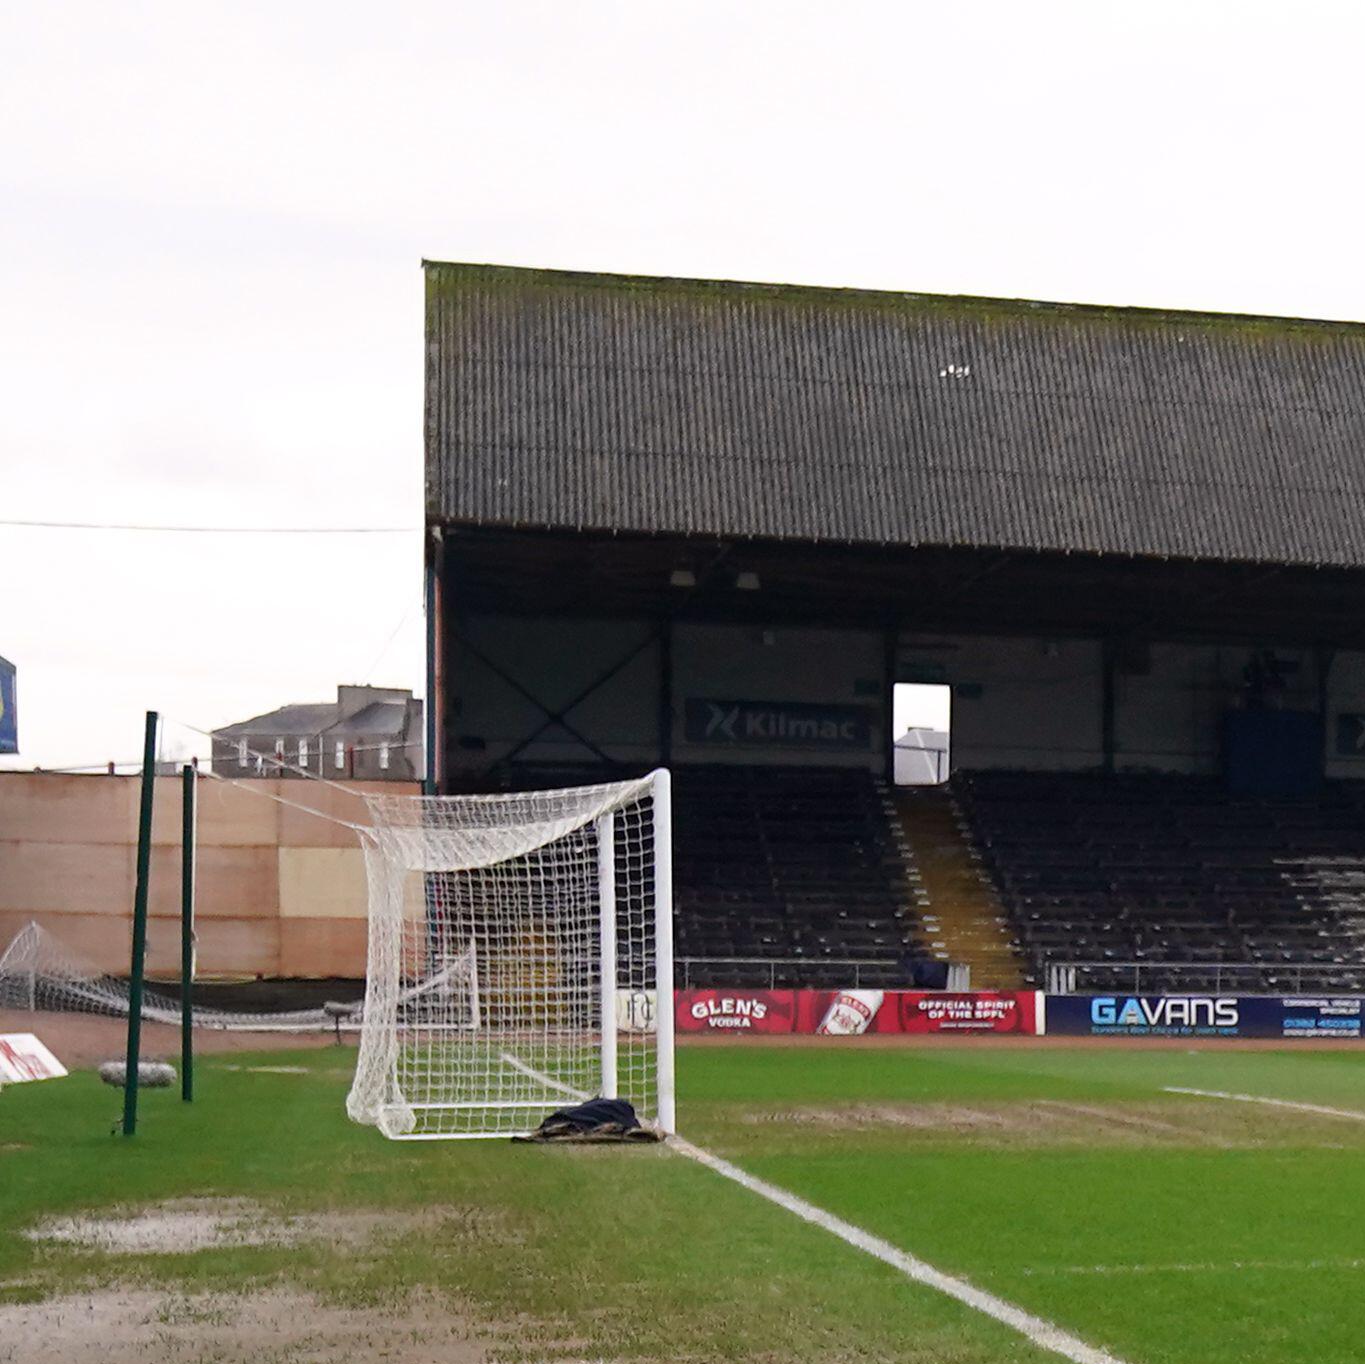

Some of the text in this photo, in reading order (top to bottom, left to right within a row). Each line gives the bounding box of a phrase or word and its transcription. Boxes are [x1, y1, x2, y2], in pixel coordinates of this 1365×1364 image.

[746, 709, 856, 740] Kilmac
[692, 998, 767, 1019] GLEN'S
[918, 1000, 1015, 1010] OFFICIAL SPIRIT
[928, 1010, 1005, 1019] OF THE SPFL
[709, 1016, 751, 1028] VODKA
